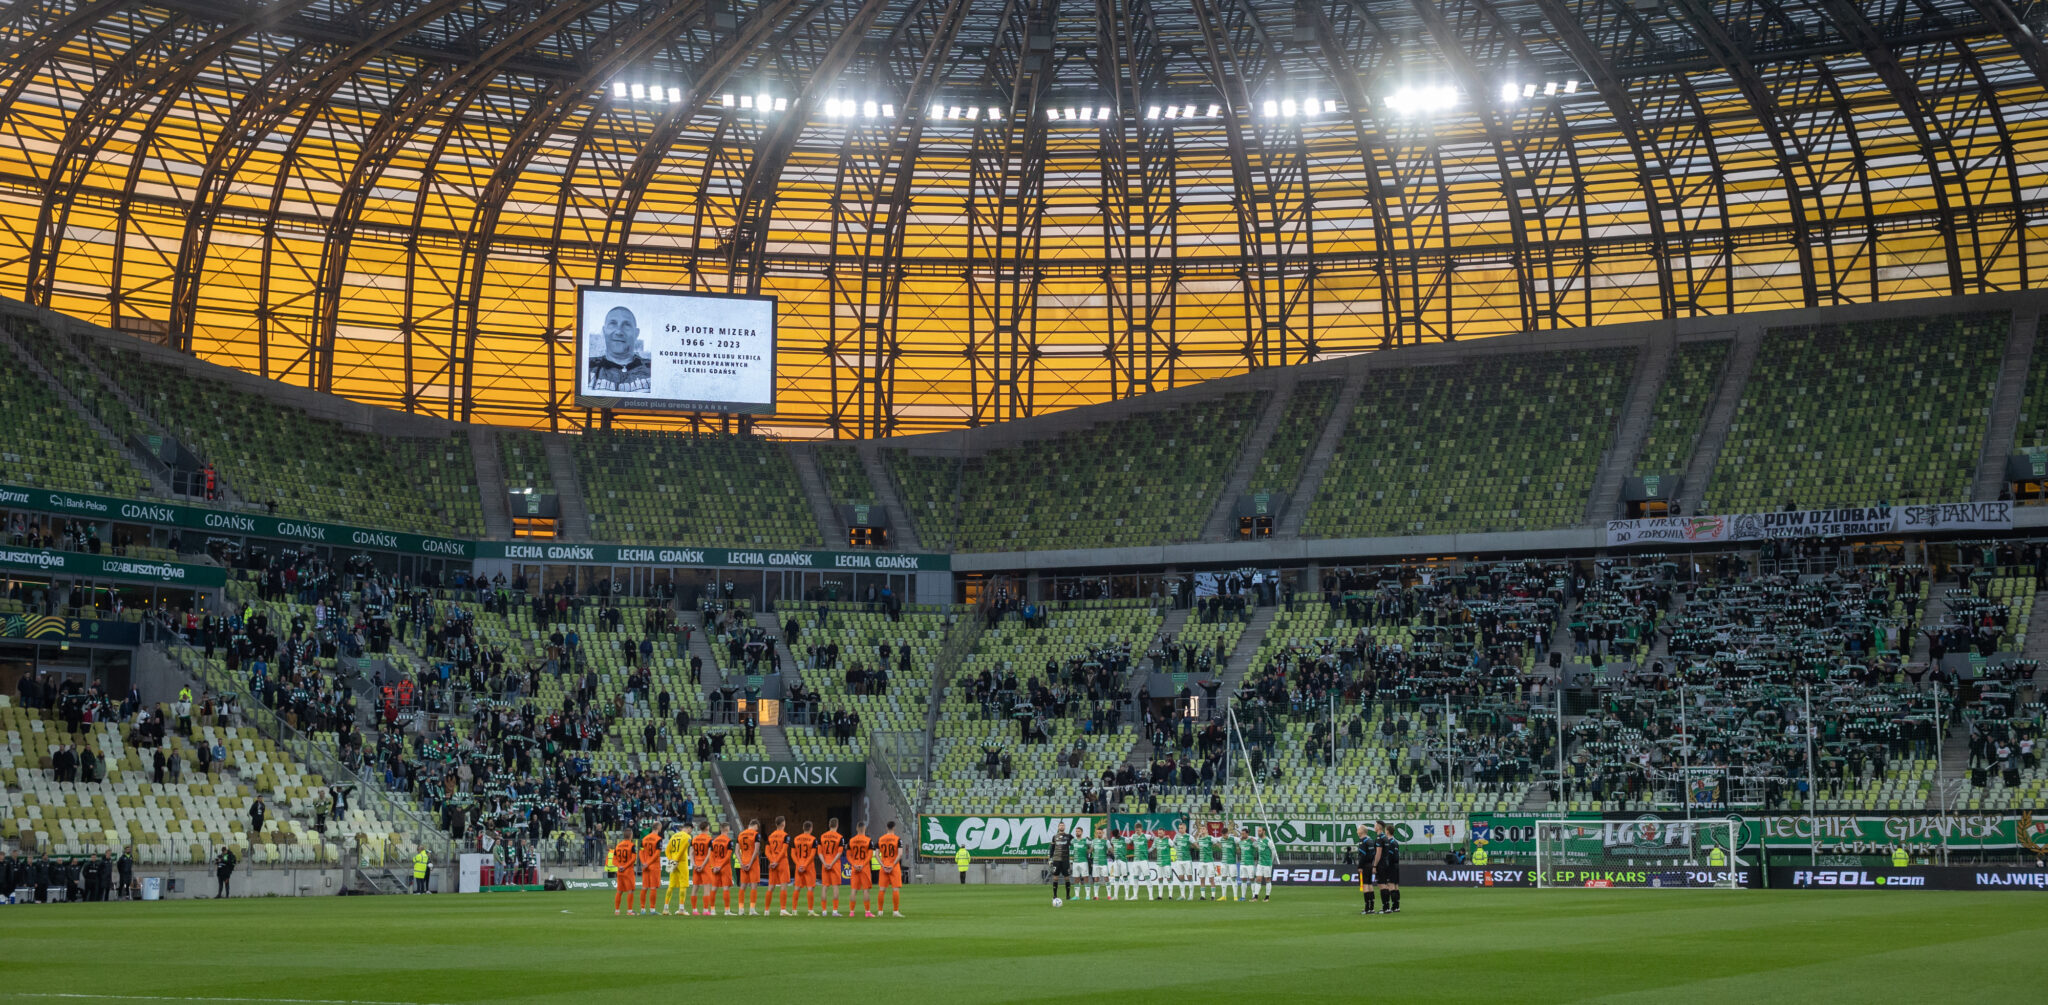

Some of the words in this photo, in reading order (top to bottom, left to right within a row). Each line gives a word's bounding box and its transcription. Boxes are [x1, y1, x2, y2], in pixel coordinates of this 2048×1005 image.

[665, 323, 680, 333] ŚP.
[684, 326, 714, 335] PIOTR
[719, 328, 756, 337] MIZERA
[681, 338, 705, 347] 1966
[717, 340, 740, 349] 2023
[660, 350, 711, 359] KOORDYNATOR
[672, 359, 748, 368] NIEPEŁNOSPRAWNYCH
[709, 367, 737, 375] GDAŃSK
[624, 400, 648, 408] polsat
[650, 400, 666, 409] plus
[66, 498, 85, 509] Bank
[86, 500, 108, 511] Pekao
[121, 504, 174, 522] GDAŃSK
[1809, 507, 1892, 524] DZIOBAK
[1941, 502, 2011, 523] FARMER
[204, 513, 255, 531] GDAŃSK
[277, 522, 325, 540] GDAŃSK
[1617, 531, 1631, 542] DO
[1638, 529, 1685, 540] ZDROWIA
[1765, 525, 1819, 538] TRZYMAJ
[1843, 522, 1891, 535] BRACIE!
[352, 531, 397, 548] GDAŃSK
[422, 538, 464, 556] GDAŃSK
[505, 545, 543, 559] LECHIA
[547, 545, 594, 560] GDAŃSK
[617, 549, 655, 562] LECHIA
[659, 548, 704, 563] GDAŃSK
[727, 552, 764, 565] LECHIA
[768, 551, 812, 566] GDAŃSK
[835, 555, 871, 568] LECHIA
[875, 554, 919, 569] GDAŃSK
[742, 762, 839, 784] GDAŃSK
[956, 817, 1092, 851] GDYNIA
[1242, 818, 1414, 843] TRÓJMIAO
[1493, 825, 1563, 843] SOPOT
[1762, 815, 1866, 839] LECHIA
[824, 840, 837, 854] 27
[853, 845, 866, 860] 26
[921, 842, 957, 852] GDYNIA
[1002, 846, 1028, 856] Lechia
[1286, 845, 1334, 853] LECHIA
[1580, 871, 1662, 883] PIŁKARS
[1685, 871, 1749, 883] POLSCE
[1975, 873, 2048, 888] NAJWIĘ
